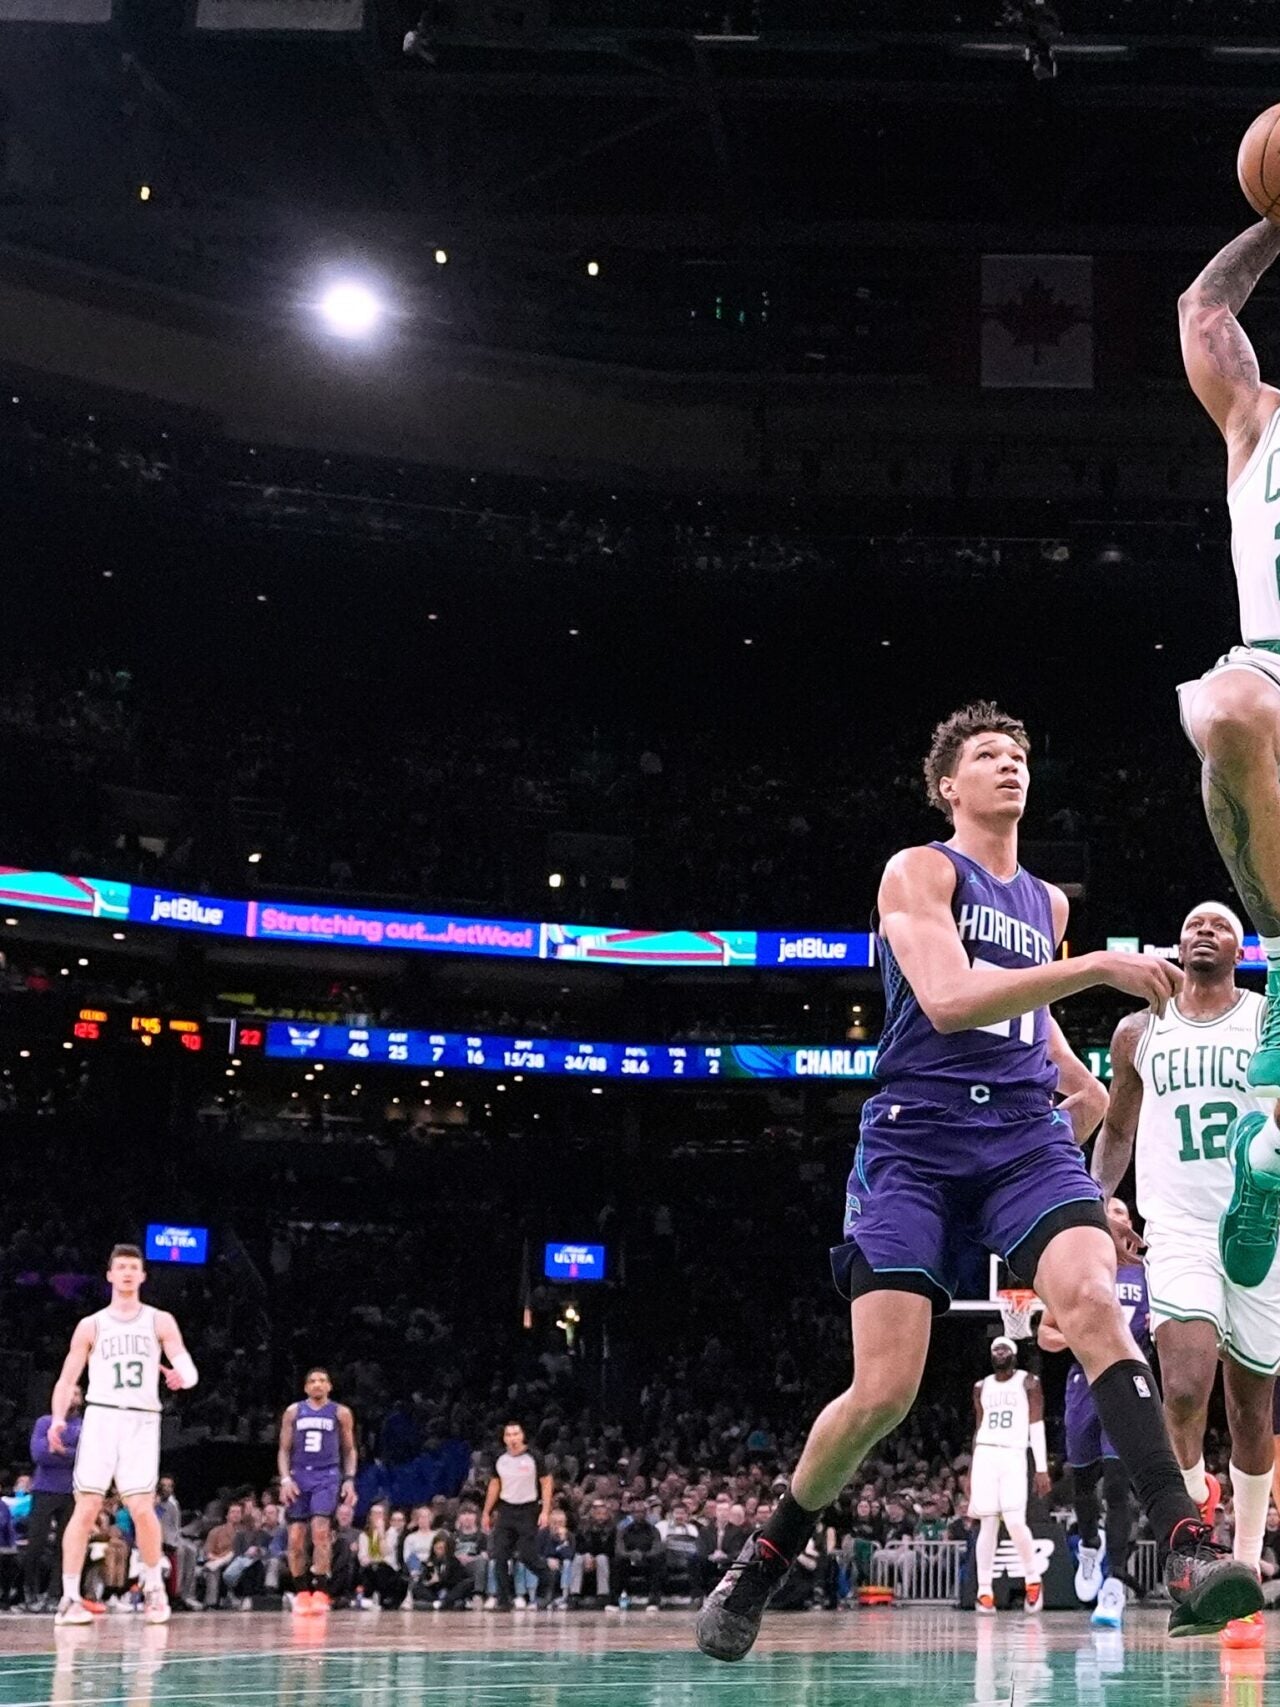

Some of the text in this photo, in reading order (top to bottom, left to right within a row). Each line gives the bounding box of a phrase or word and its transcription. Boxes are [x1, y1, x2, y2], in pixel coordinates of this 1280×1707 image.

[151, 895, 224, 925] jetBlue
[262, 908, 383, 942] Stretching
[958, 904, 1052, 966] HORNETS
[778, 938, 847, 963] jetBlue
[74, 1022, 99, 1038] 125
[239, 1029, 262, 1045] 22
[388, 1045, 409, 1060] 25
[432, 1047, 444, 1061] 7
[467, 1050, 485, 1065] 16
[504, 1052, 545, 1068] 15/38
[564, 1055, 607, 1072] 34/88
[621, 1059, 650, 1074] 38.6
[673, 1059, 684, 1074] 2
[709, 1060, 720, 1074] 2
[1151, 1045, 1250, 1097] CELTICS
[1174, 1101, 1239, 1162] 12
[155, 1234, 197, 1247] ULTRA
[554, 1252, 595, 1264] ULTRA
[101, 1334, 151, 1360] CELTICS
[112, 1361, 144, 1389] 13
[988, 1410, 1013, 1430] 88
[304, 1430, 323, 1452] 3
